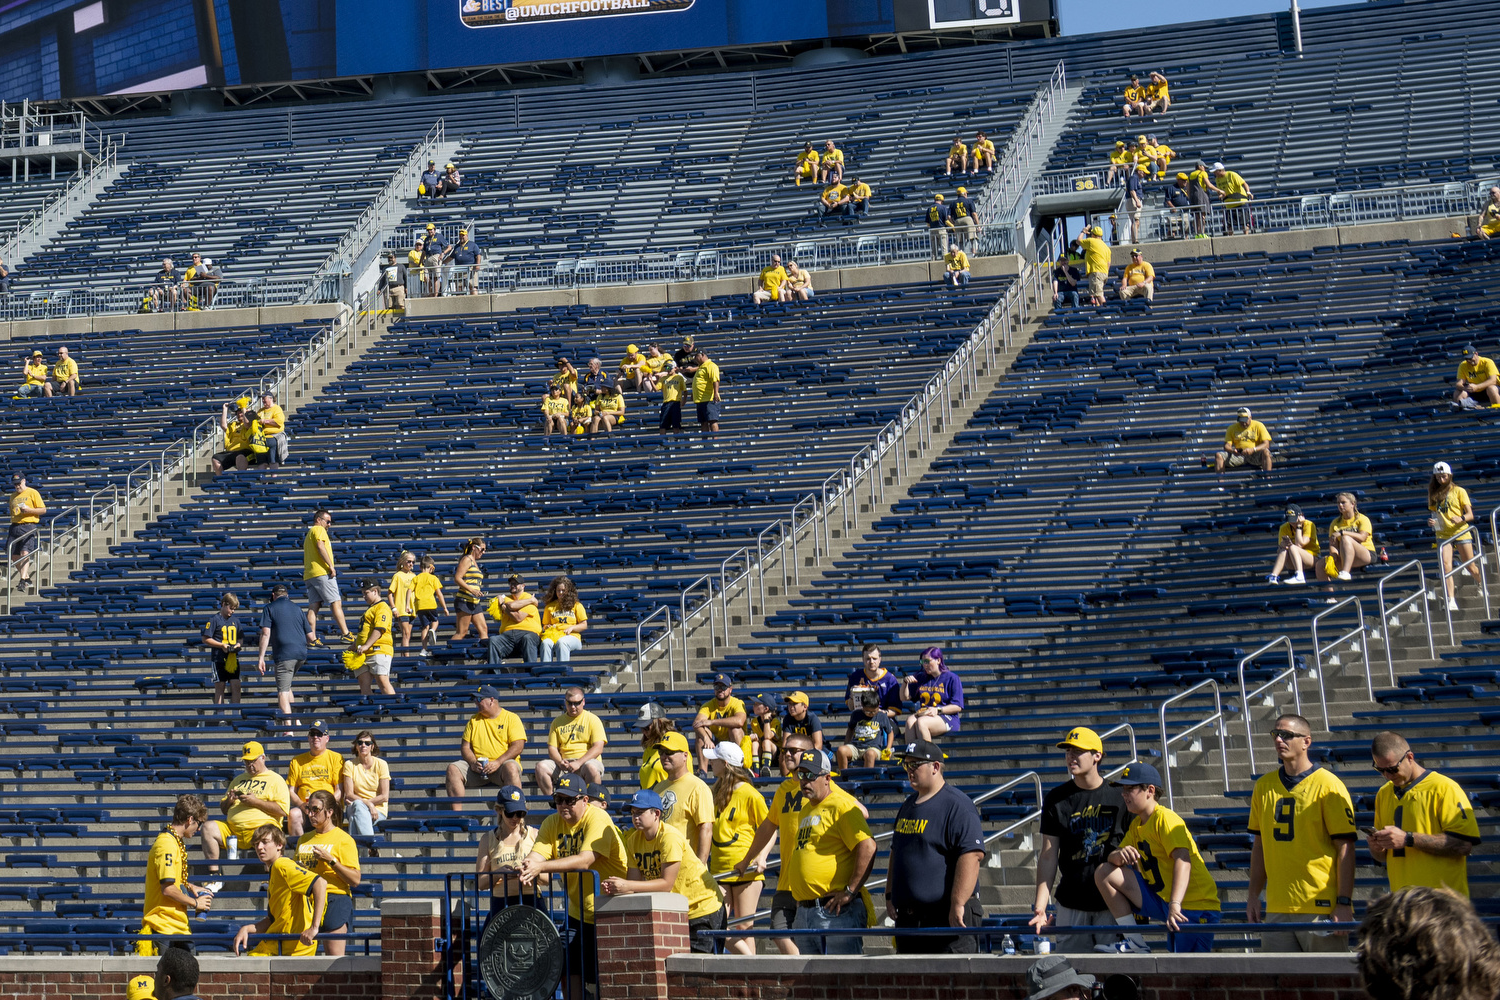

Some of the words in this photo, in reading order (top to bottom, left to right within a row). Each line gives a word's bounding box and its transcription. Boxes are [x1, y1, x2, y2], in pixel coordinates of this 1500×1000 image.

[1075, 180, 1094, 191] 36
[381, 614, 386, 622] 9
[558, 616, 567, 624] M
[221, 626, 237, 646] 10
[559, 725, 585, 735] MICHIGAN
[1069, 732, 1079, 740] M
[803, 753, 814, 761] M
[238, 779, 267, 791] 2023
[560, 778, 571, 787] M
[782, 790, 804, 814] M
[1344, 806, 1356, 826] 9
[1457, 802, 1468, 820] 1
[1273, 797, 1296, 842] 9
[894, 818, 929, 834] MICHIGAN
[1393, 805, 1406, 858] 1
[165, 853, 173, 867] 5
[138, 980, 148, 988] M
